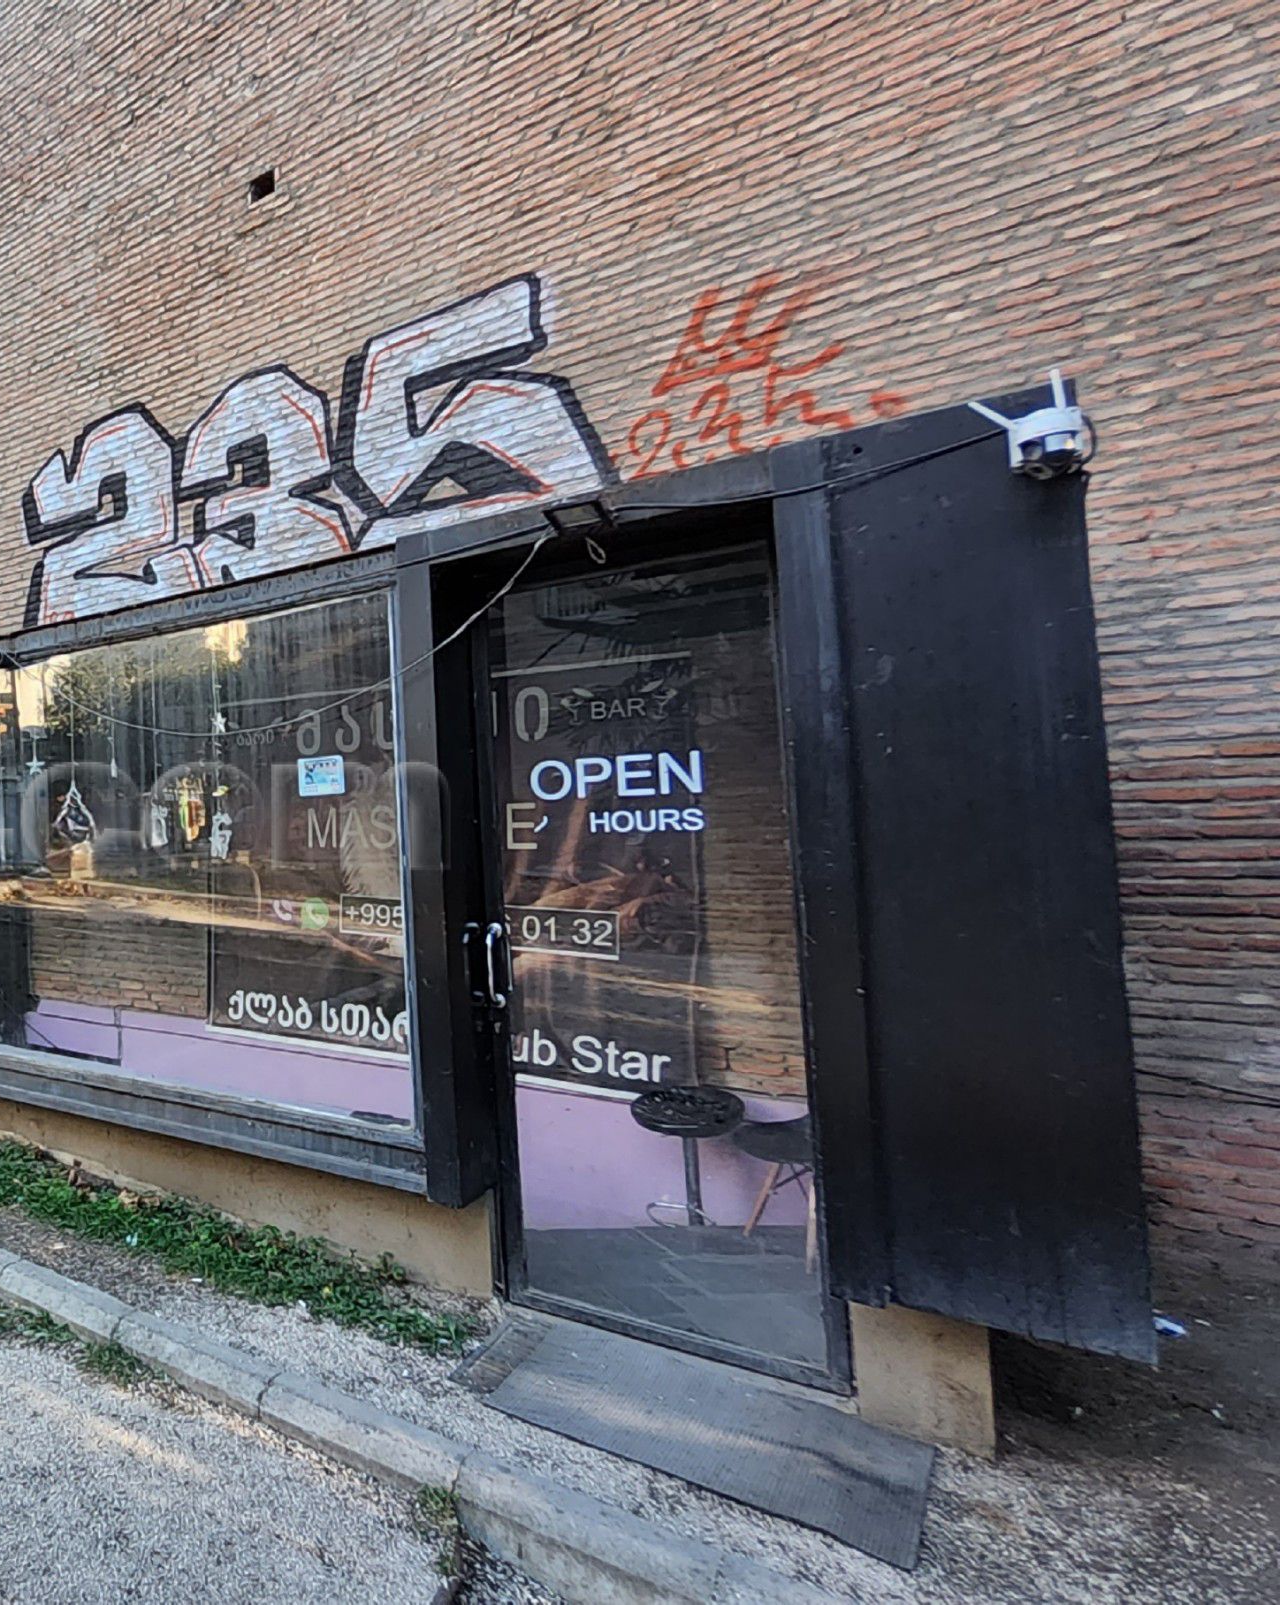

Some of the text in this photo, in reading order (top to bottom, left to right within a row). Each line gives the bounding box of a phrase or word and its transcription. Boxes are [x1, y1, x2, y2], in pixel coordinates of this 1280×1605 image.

[590, 698, 646, 720] BAR
[530, 750, 704, 800] OPEN
[589, 808, 705, 833] HOURS
[522, 915, 557, 942] 01
[572, 918, 613, 947] 32
[571, 1035, 671, 1083] Star
